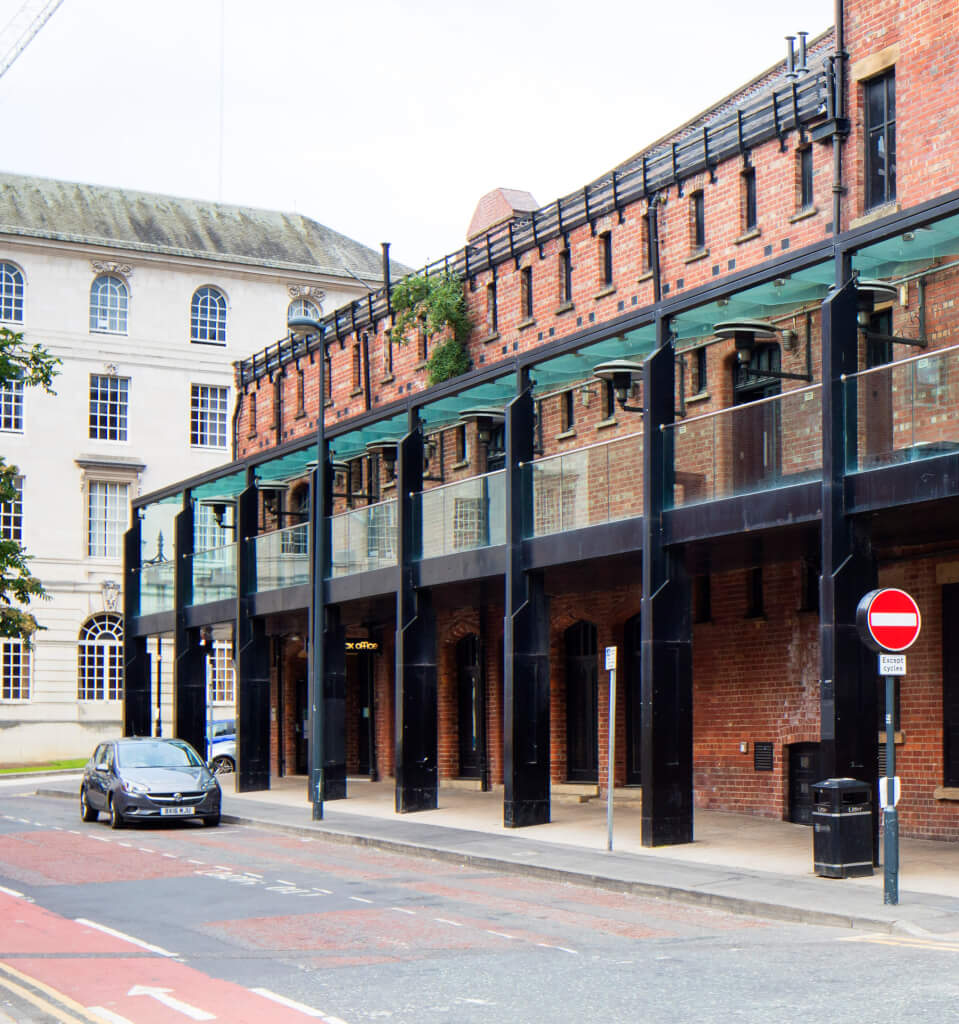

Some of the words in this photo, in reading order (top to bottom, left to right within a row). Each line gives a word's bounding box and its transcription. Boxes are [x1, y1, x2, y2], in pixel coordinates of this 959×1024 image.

[355, 641, 378, 650] office
[882, 656, 904, 664] Except
[883, 665, 903, 673] cycles
